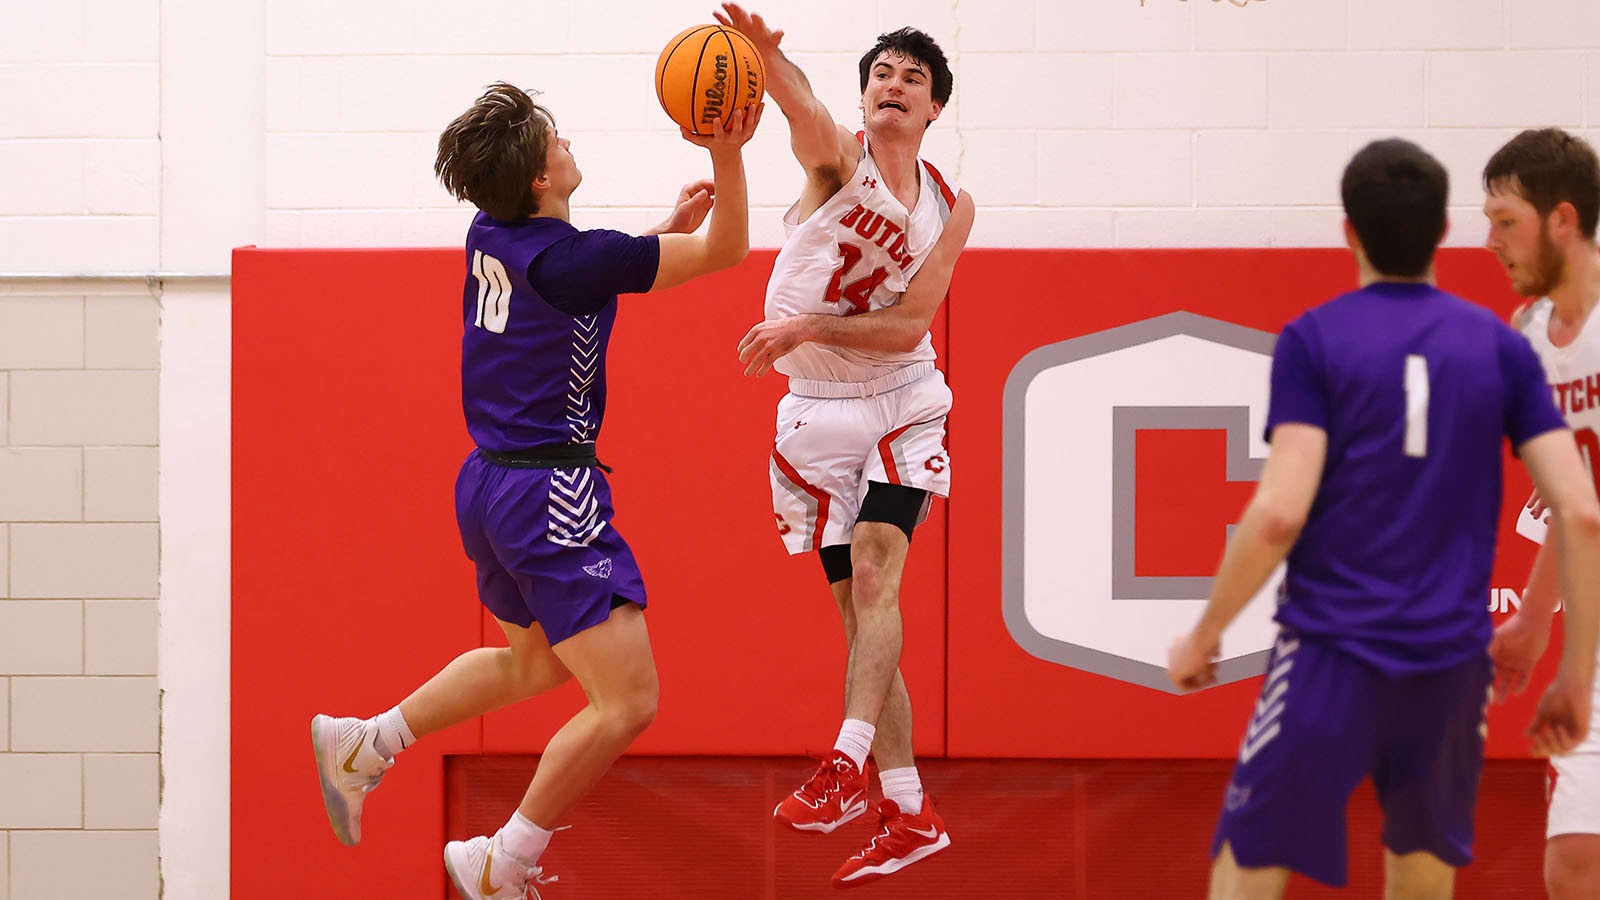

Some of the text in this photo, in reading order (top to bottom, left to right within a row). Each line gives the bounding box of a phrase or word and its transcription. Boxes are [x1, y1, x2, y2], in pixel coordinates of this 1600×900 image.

[702, 54, 728, 124] Wilson
[471, 248, 513, 334] 10
[1404, 353, 1430, 458] 1
